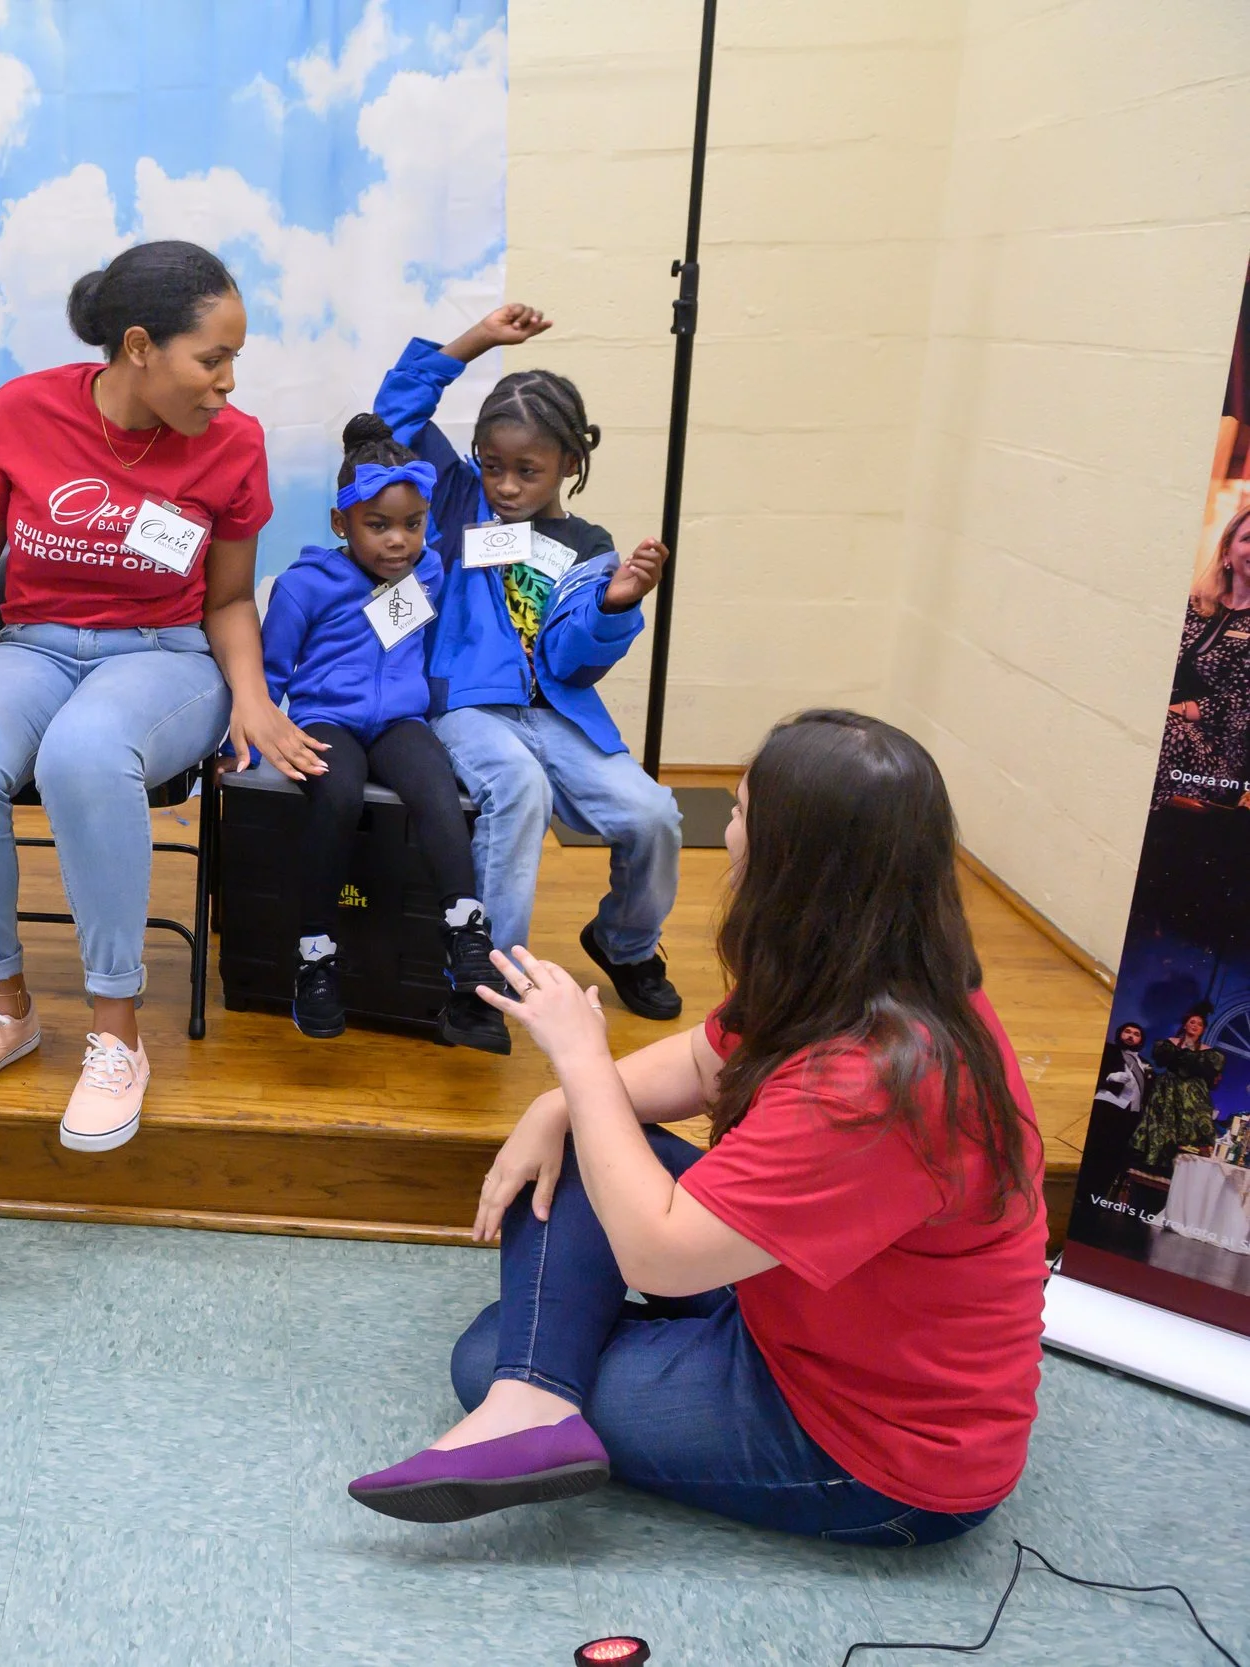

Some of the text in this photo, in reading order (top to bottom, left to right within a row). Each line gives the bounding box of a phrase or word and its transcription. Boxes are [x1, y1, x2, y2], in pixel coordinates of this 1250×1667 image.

[48, 477, 138, 531] Ope
[15, 518, 144, 557] BUILDING COM
[97, 520, 131, 533] BALT
[140, 519, 189, 550] Opera
[13, 531, 174, 574] THROUGH OPE
[157, 540, 186, 557] BALTIMORE
[1170, 769, 1216, 786] Opera
[1220, 778, 1239, 790] on
[1090, 1193, 1136, 1216] Verdi's
[1138, 1209, 1157, 1223] La
[1160, 1215, 1217, 1240] traviata
